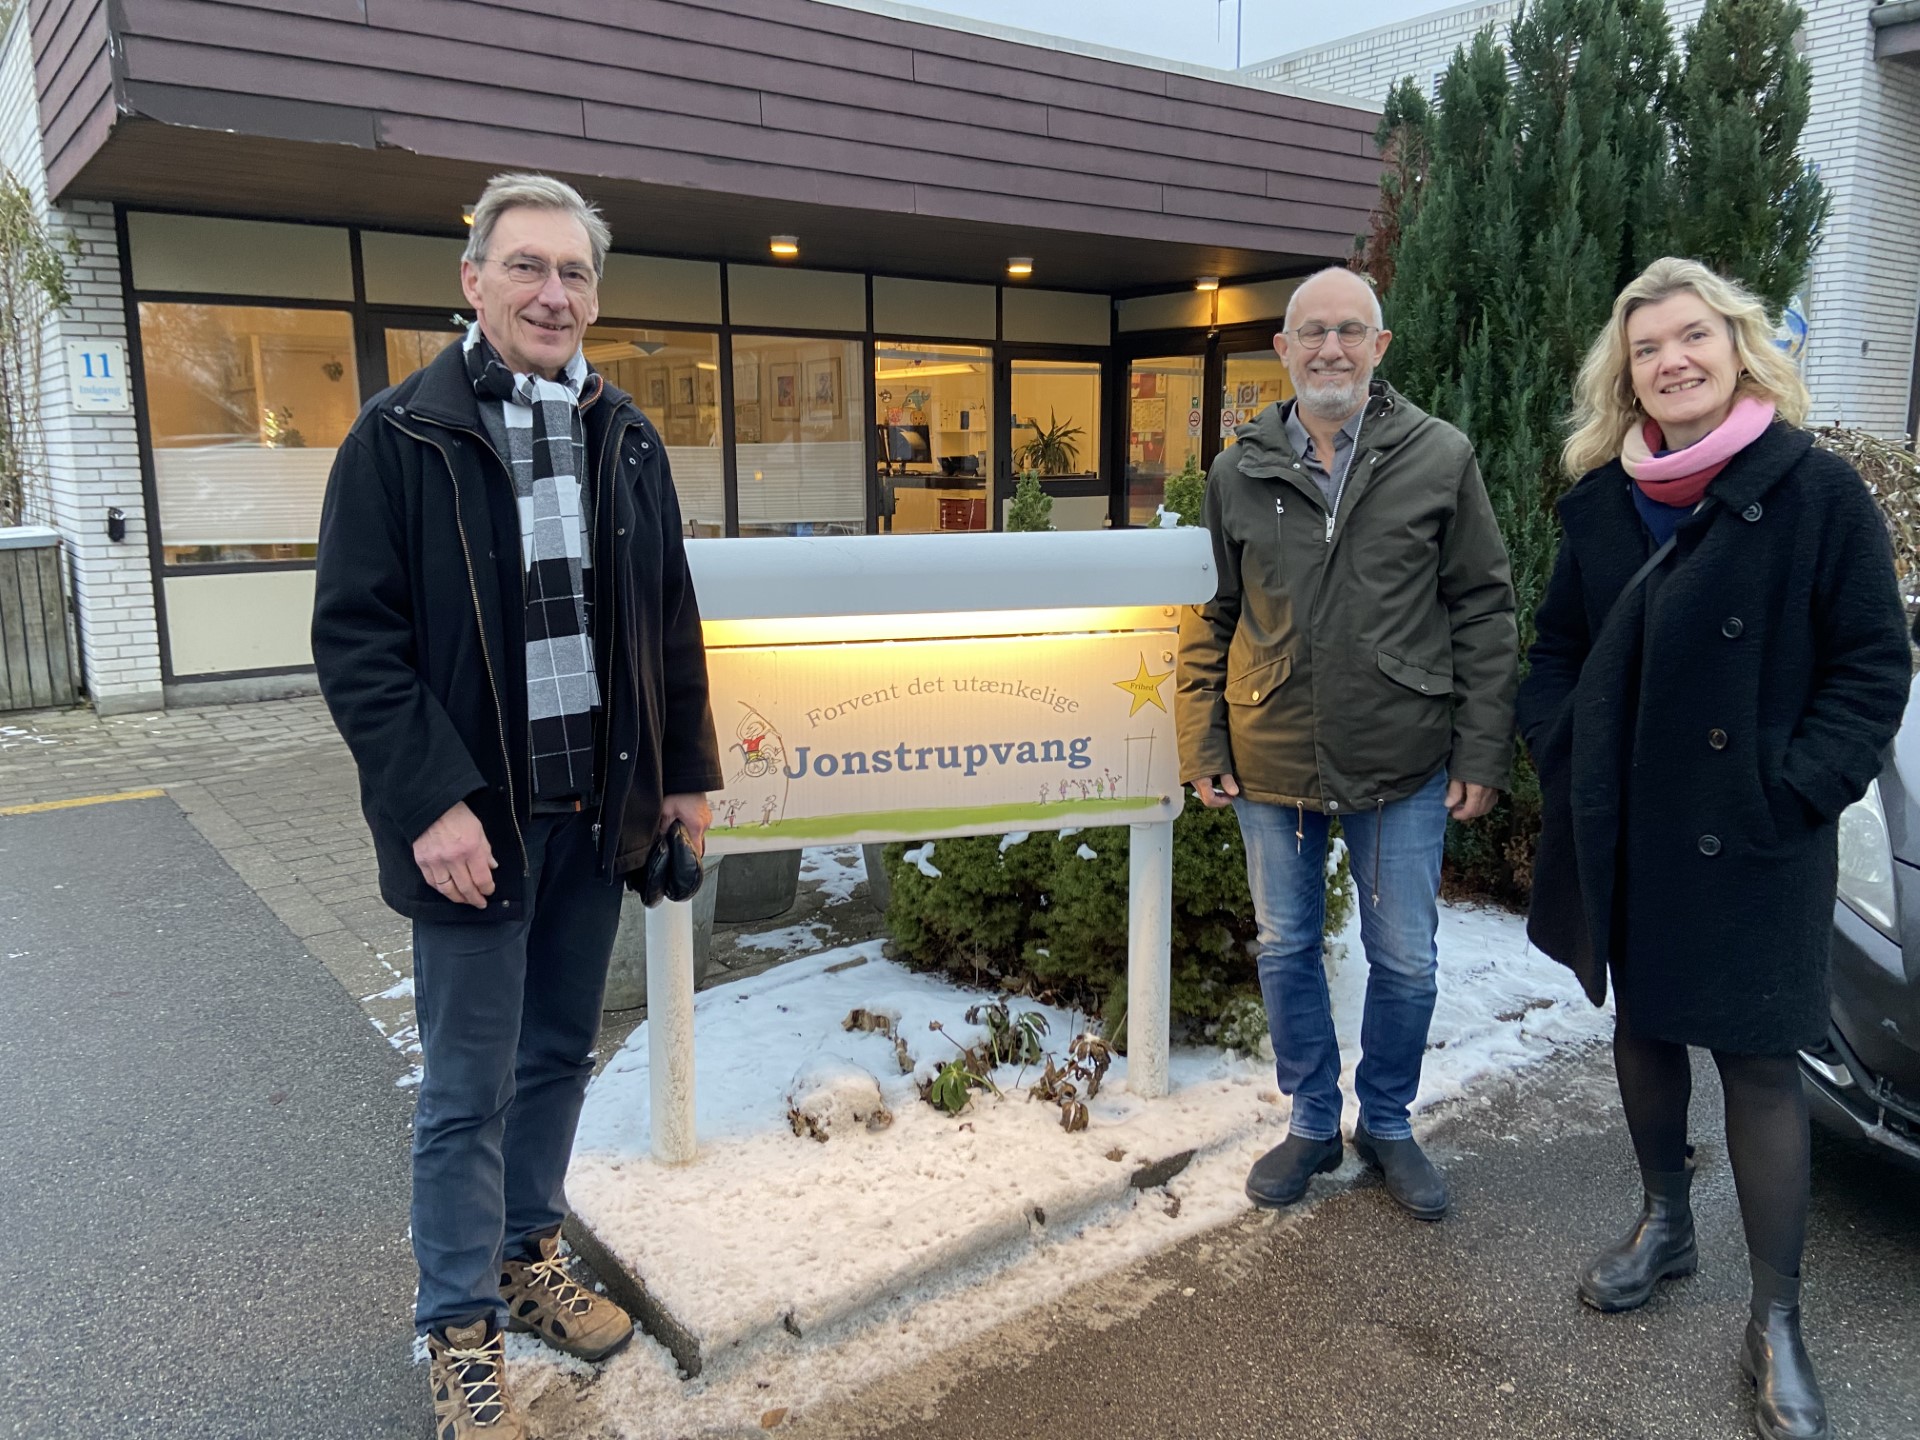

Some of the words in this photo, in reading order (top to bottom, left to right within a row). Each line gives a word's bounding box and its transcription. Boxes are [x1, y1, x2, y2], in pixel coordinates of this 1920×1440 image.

[80, 352, 114, 378] 11
[805, 683, 901, 729] Forvent
[907, 676, 945, 696] det
[952, 676, 1080, 713] utænkelige
[1130, 682, 1154, 691] Frihed
[783, 736, 1092, 779] Jonstrupvang
